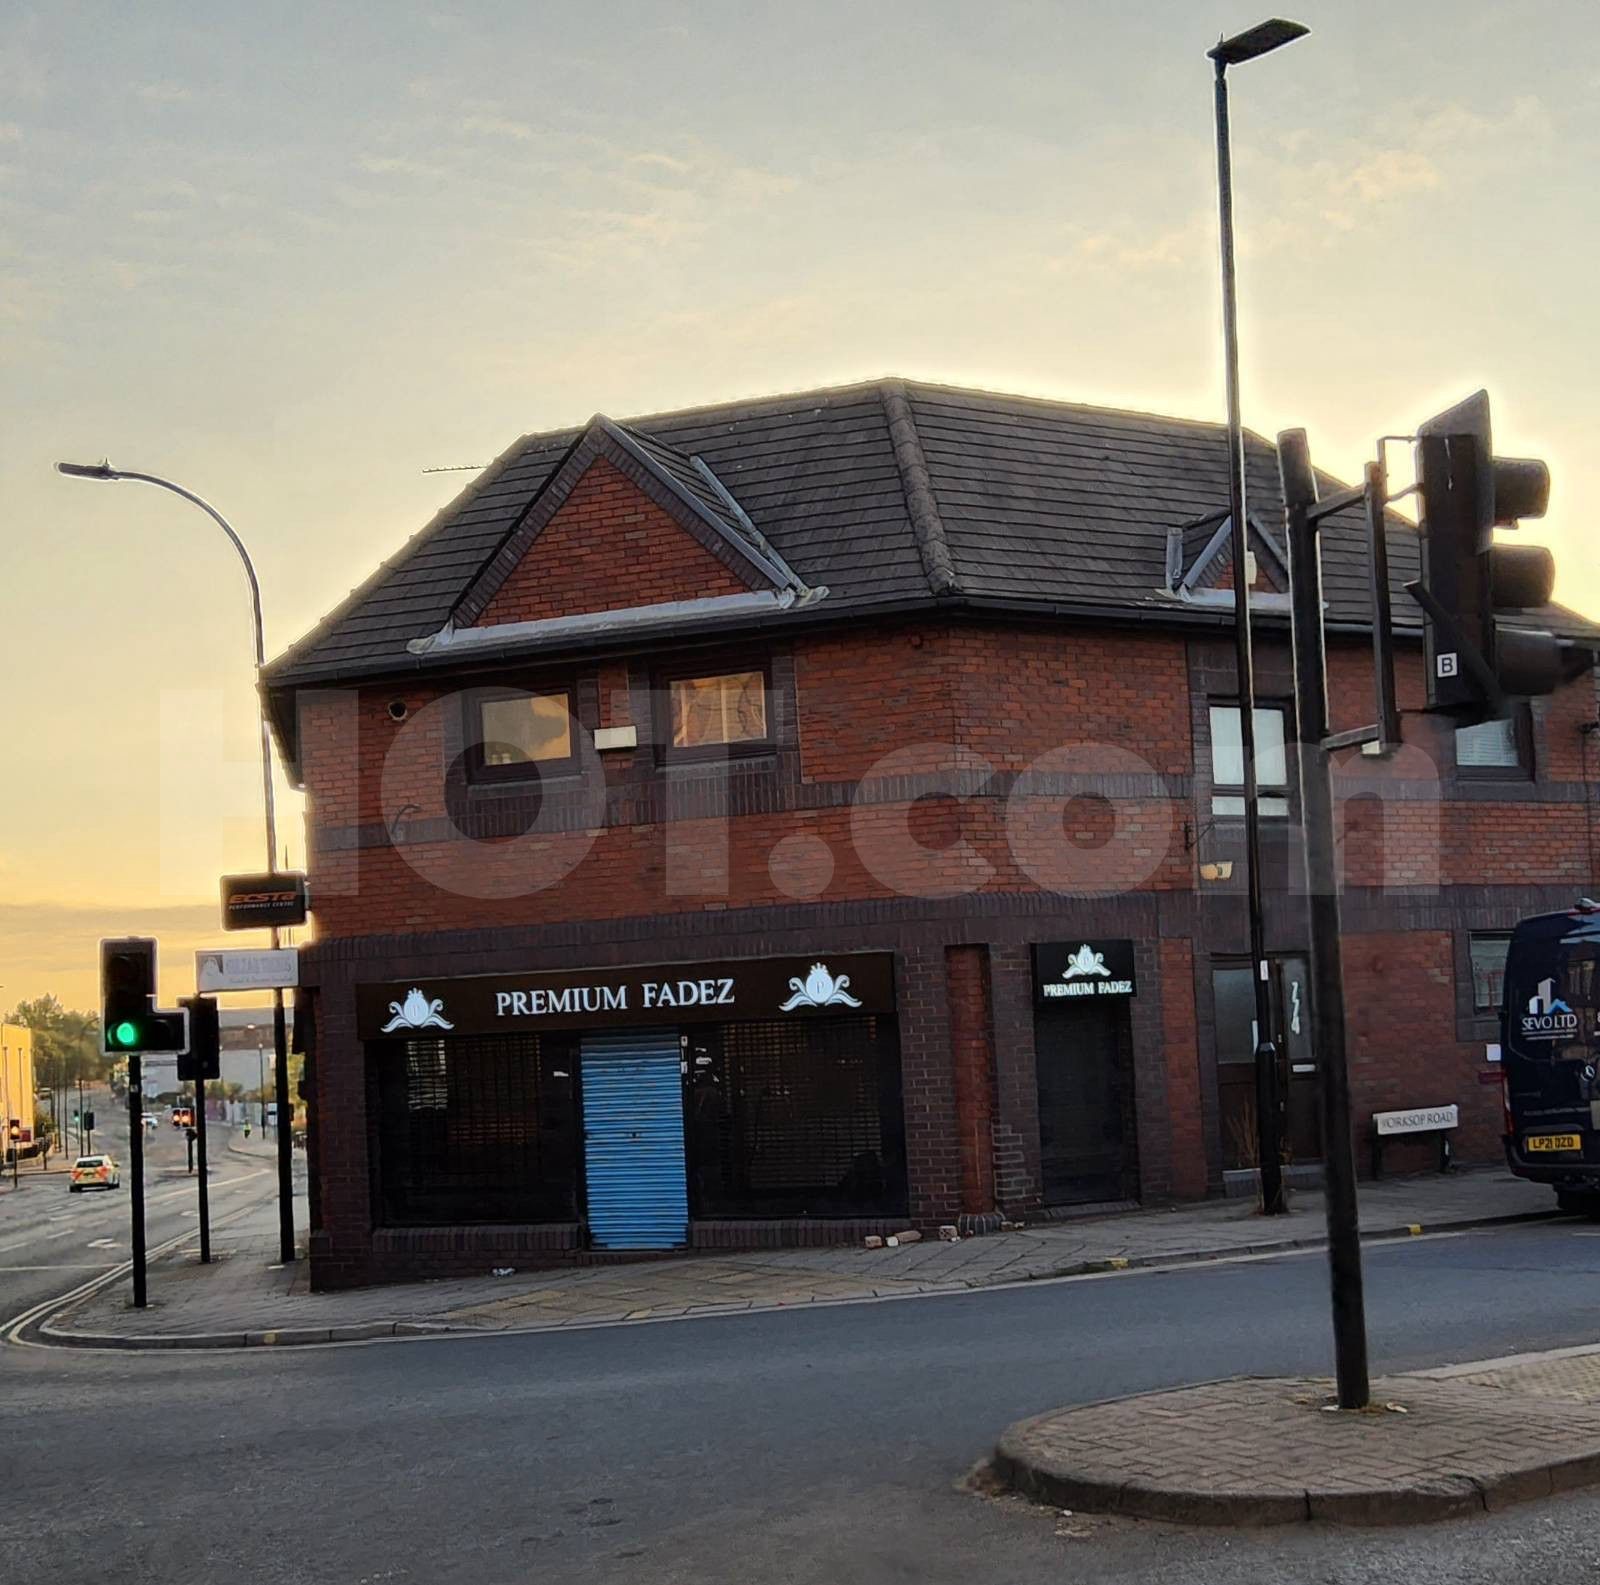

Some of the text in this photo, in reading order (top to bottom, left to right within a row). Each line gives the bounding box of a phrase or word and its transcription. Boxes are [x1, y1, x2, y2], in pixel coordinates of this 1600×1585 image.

[1442, 657, 1453, 673] B
[1043, 980, 1132, 997] PREMIUM FADEZ
[496, 978, 736, 1017] PREMIUM FADEZ
[1522, 1015, 1553, 1031] SEVO
[1554, 1013, 1578, 1029] LTD
[1427, 1110, 1454, 1125] ROAD
